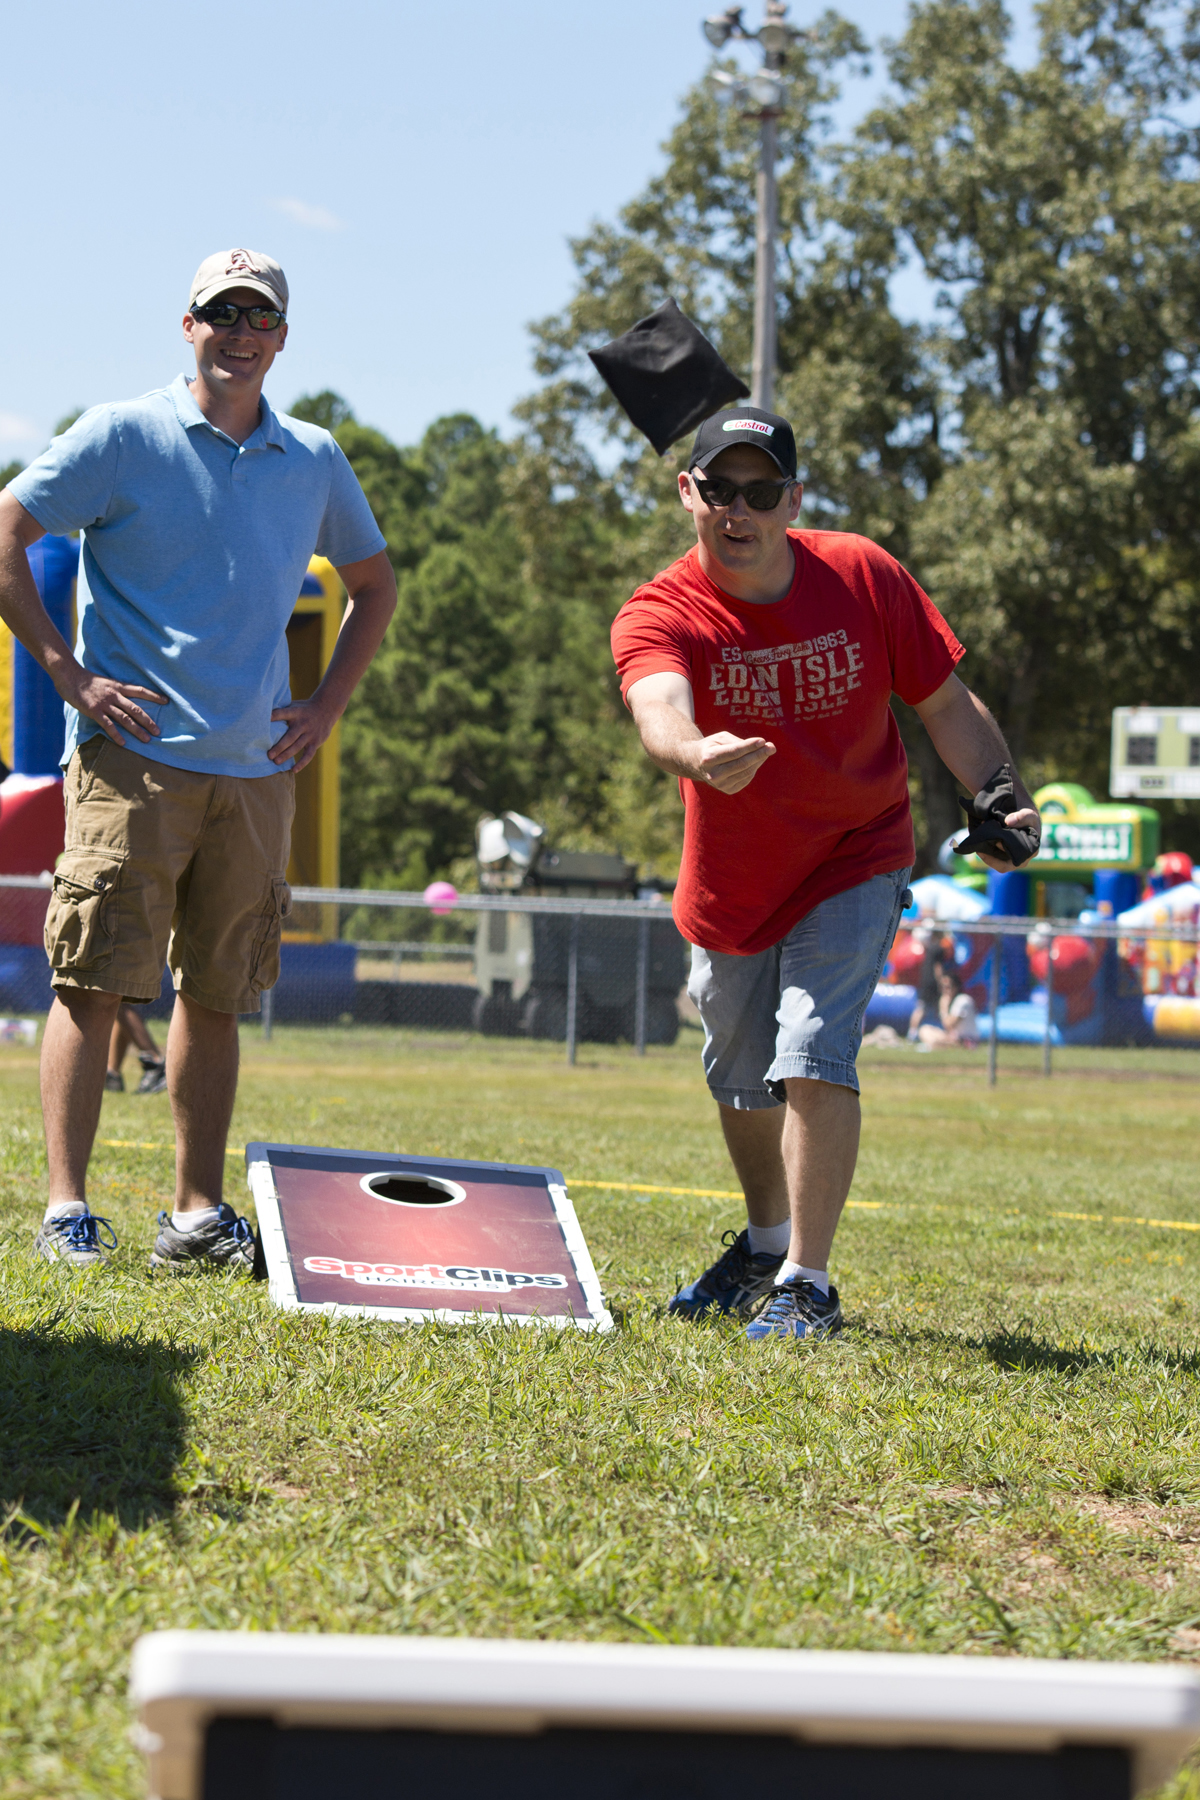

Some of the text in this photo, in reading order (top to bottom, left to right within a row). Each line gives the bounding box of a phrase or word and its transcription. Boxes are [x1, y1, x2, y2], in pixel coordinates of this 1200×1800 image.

[734, 421, 769, 433] Castrol
[812, 629, 848, 653] 1963
[709, 642, 864, 691] EDN ISLE
[365, 1276, 501, 1290] HAIRCUTS
